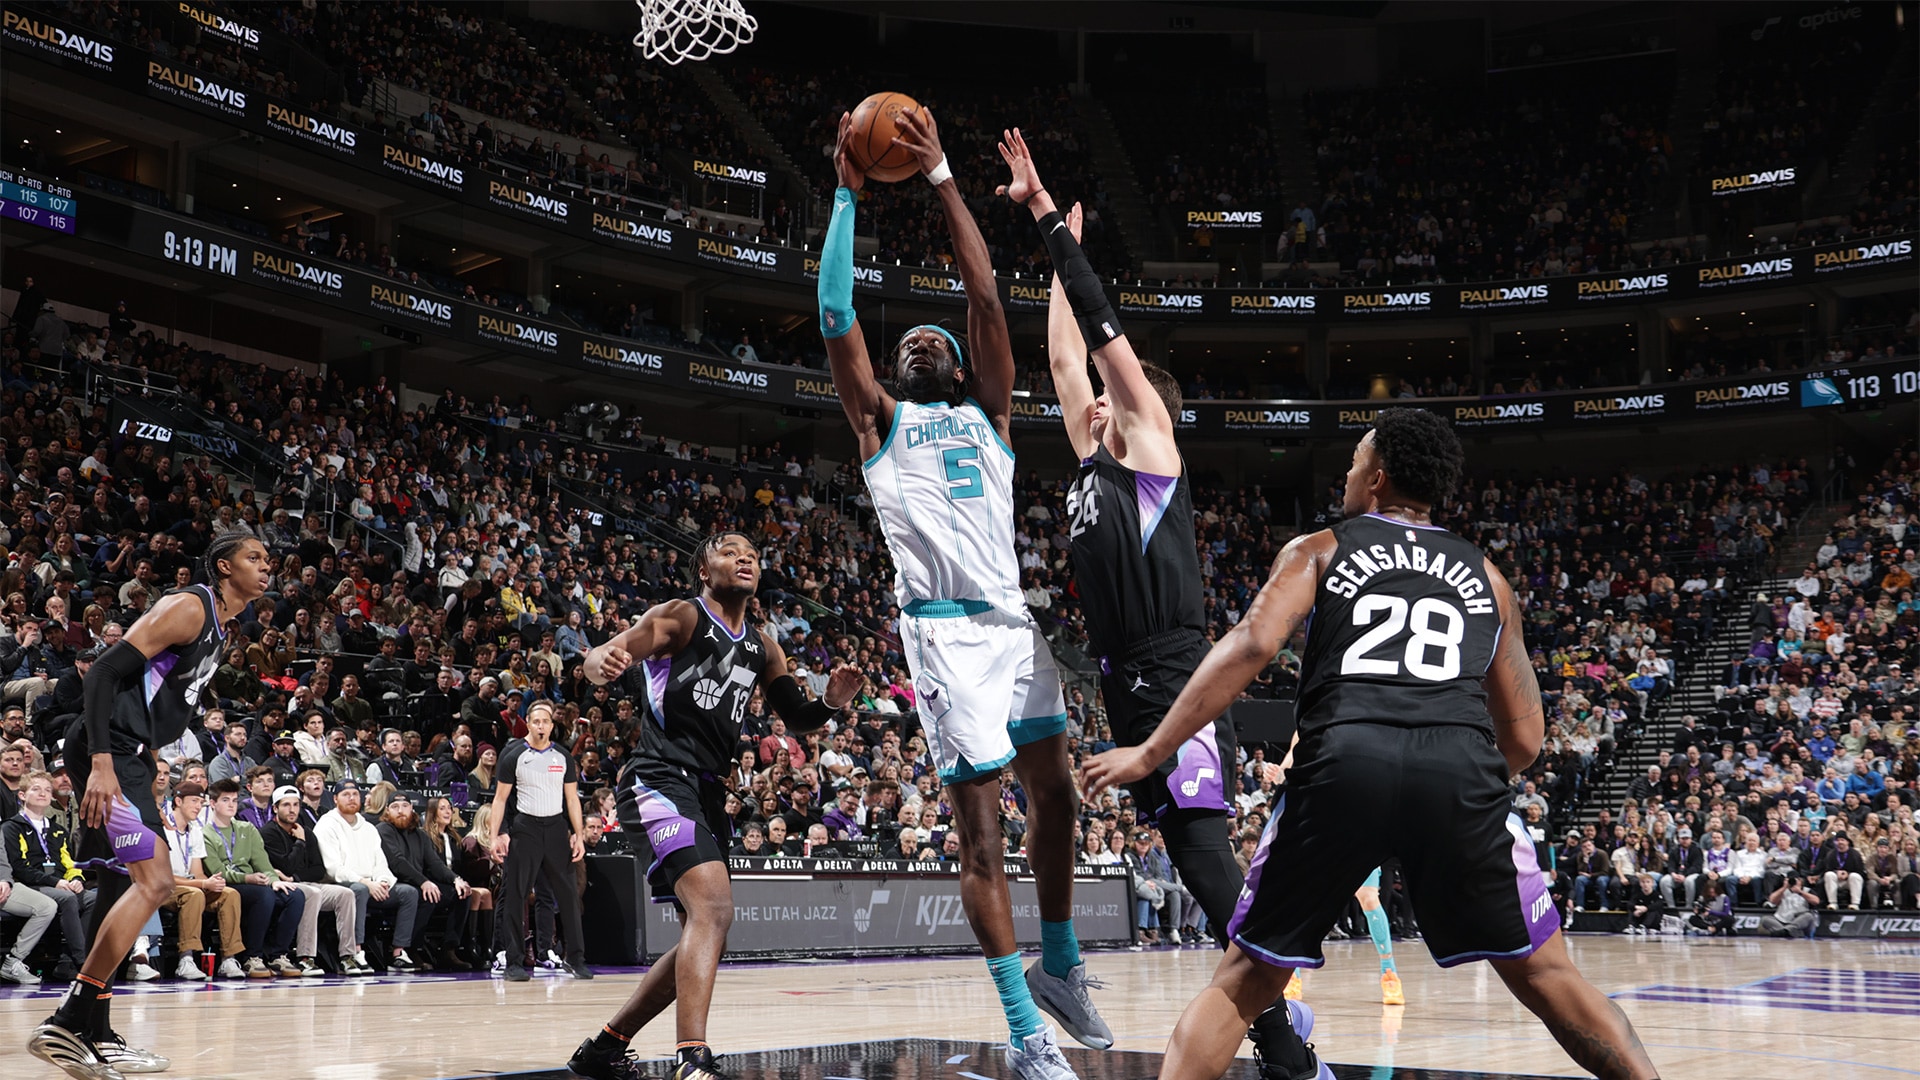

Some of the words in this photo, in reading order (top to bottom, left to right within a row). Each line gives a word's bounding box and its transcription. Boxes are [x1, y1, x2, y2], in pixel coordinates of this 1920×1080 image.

[3, 29, 36, 47] Property
[39, 41, 82, 62] Restoration
[85, 57, 112, 72] Experts
[148, 79, 178, 95] Property
[180, 91, 218, 108] Restoration
[220, 103, 245, 117] Experts
[267, 120, 294, 135] Property
[296, 130, 331, 147] Restoration
[332, 143, 355, 155] Experts
[21, 189, 38, 203] 115
[49, 198, 69, 212] 107
[18, 206, 38, 221] 107
[49, 215, 66, 229] 115
[164, 231, 203, 267] 9:13
[208, 243, 237, 277] PM
[1847, 375, 1880, 399] 113
[1891, 371, 1920, 395] 10
[942, 447, 984, 499] 5
[1067, 490, 1099, 540] 24
[1325, 543, 1493, 615] SENSABAUGH
[1340, 594, 1464, 681] 28
[731, 687, 749, 723] 13
[115, 832, 142, 849] UTAH
[653, 822, 681, 846] UTAH
[729, 858, 751, 869] ELTA
[773, 859, 803, 869] DELTA
[824, 860, 852, 870] DELTA
[870, 861, 898, 870] DELTA
[915, 862, 941, 871] DELTA
[1004, 865, 1021, 873] ELTA
[1107, 867, 1127, 875] DELTA
[733, 906, 759, 921] THE
[763, 906, 800, 921] UTAH
[803, 906, 838, 921] JAZZ
[915, 895, 966, 935] KJZZ
[1096, 904, 1119, 917] JAZZ
[1871, 918, 1911, 935] KJZZ
